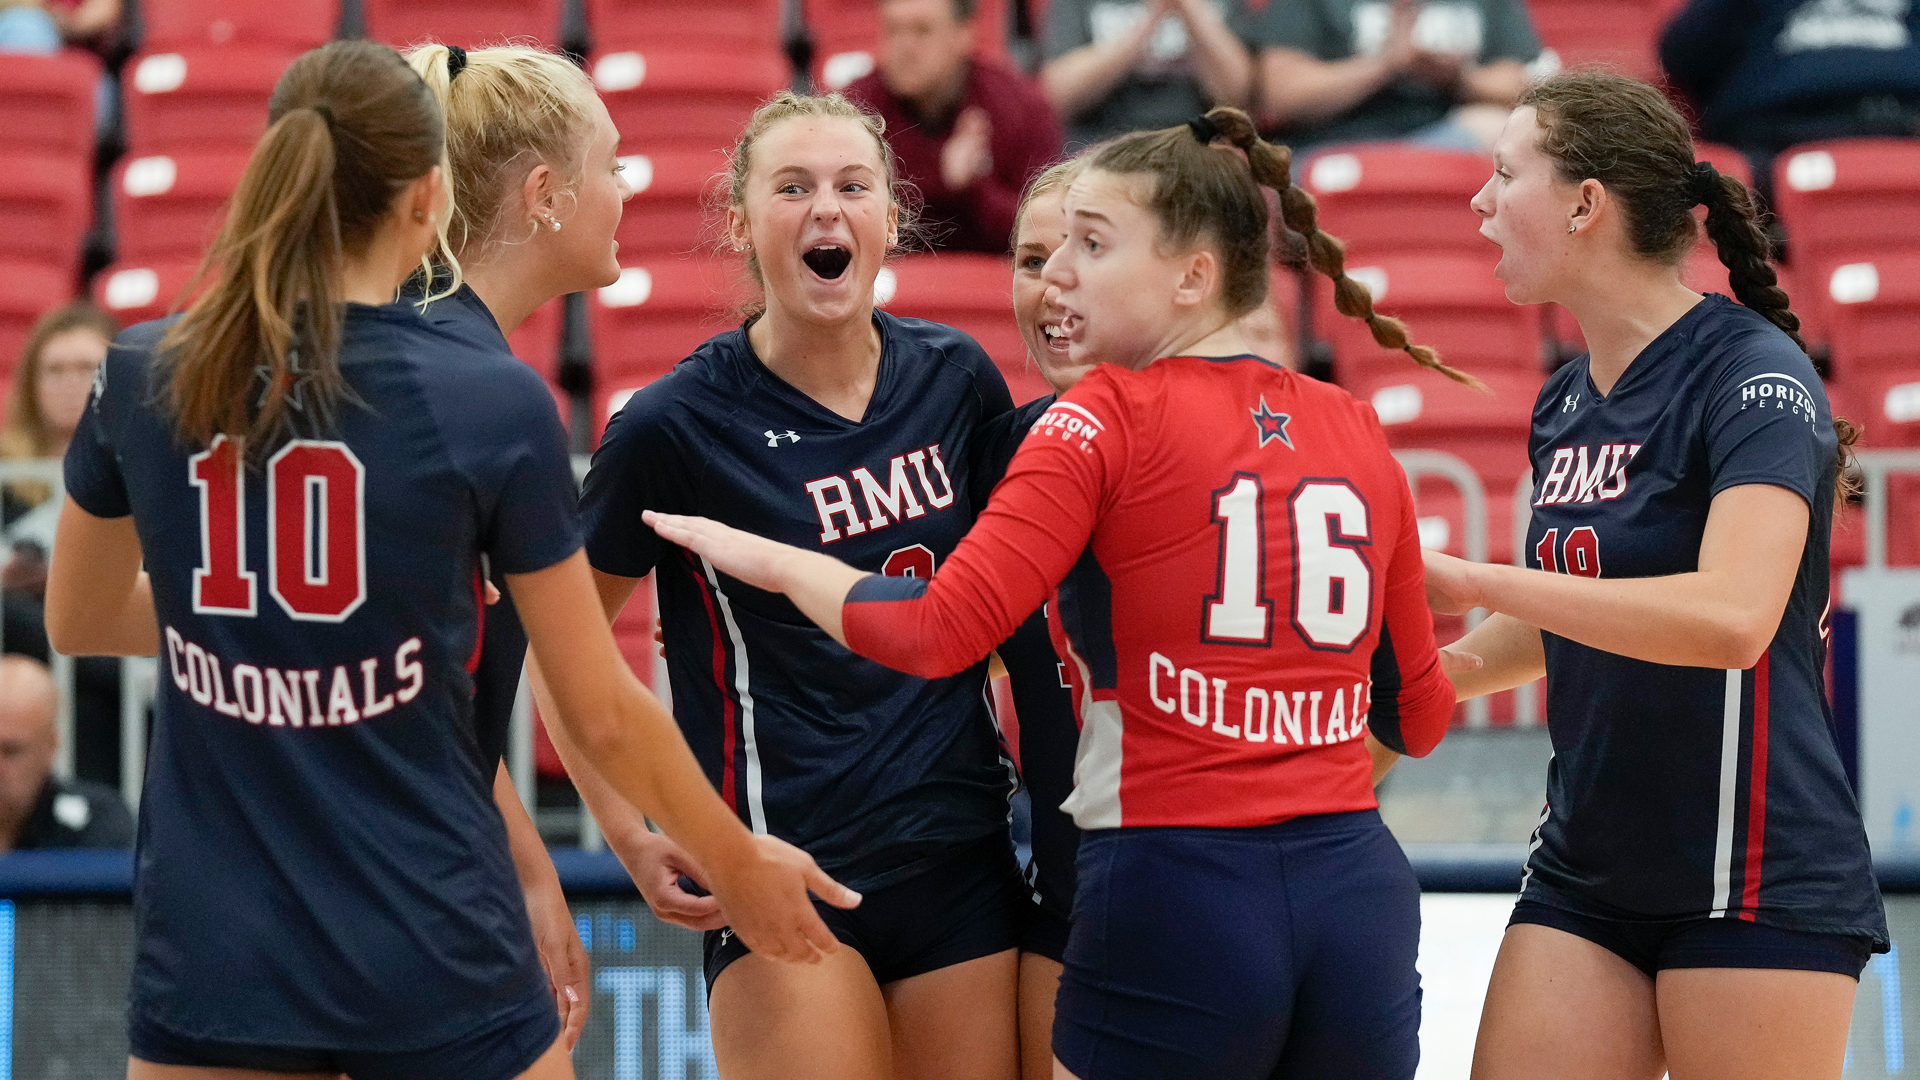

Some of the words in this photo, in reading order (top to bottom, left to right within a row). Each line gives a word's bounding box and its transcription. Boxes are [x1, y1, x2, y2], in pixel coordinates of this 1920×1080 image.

[1030, 411, 1098, 441] RIZON
[1742, 383, 1816, 423] HORIZON
[804, 443, 955, 545] RMU
[1532, 443, 1642, 507] RMU
[188, 432, 367, 623] 10
[1200, 470, 1373, 653] 16
[165, 625, 424, 728] COLONIALS
[1149, 651, 1373, 746] COLONIAL
